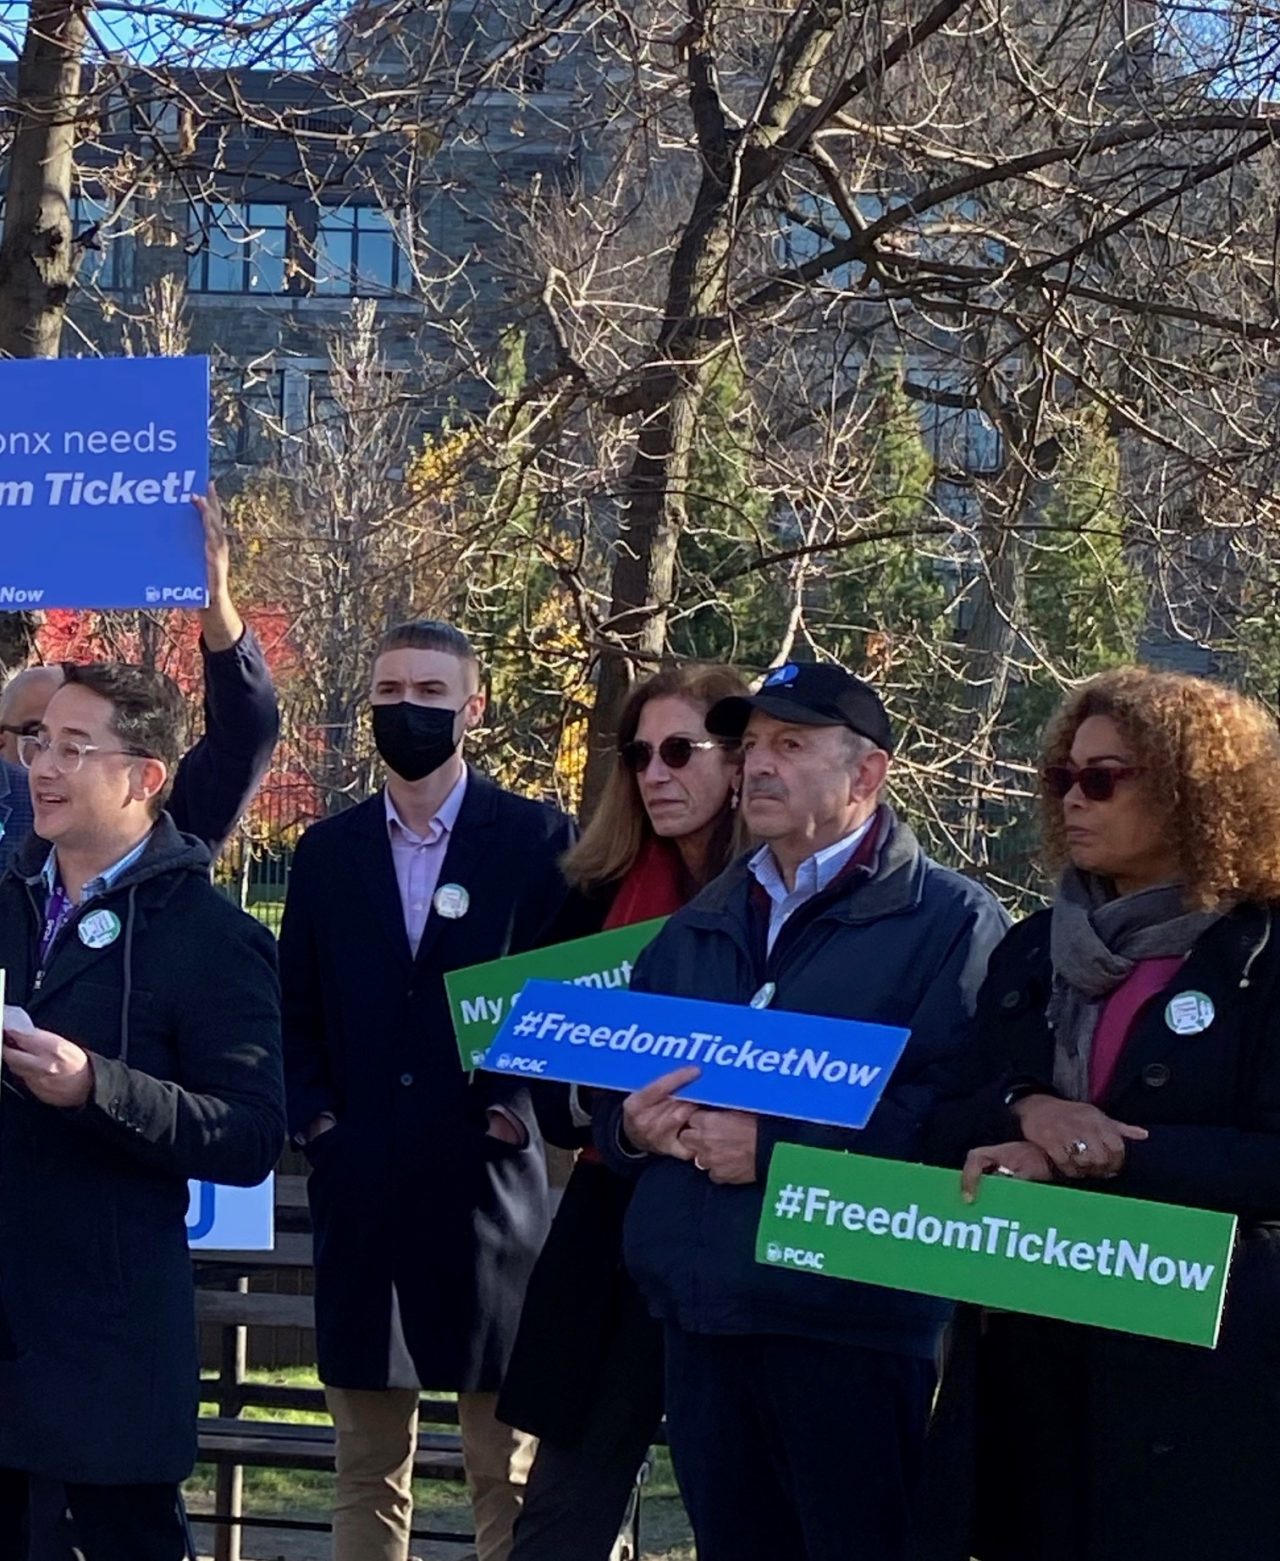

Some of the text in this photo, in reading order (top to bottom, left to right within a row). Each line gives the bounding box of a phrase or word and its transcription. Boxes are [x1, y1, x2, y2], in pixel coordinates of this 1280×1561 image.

[64, 421, 177, 454] needs
[45, 470, 196, 505] Ticket!
[162, 586, 203, 601] PCAC
[460, 996, 503, 1025] My
[513, 1010, 882, 1088] #FreedomTicketNow
[510, 1057, 548, 1074] PCAC
[774, 1183, 1215, 1291] #FreedomTicketNow
[783, 1247, 825, 1270] PCAC
